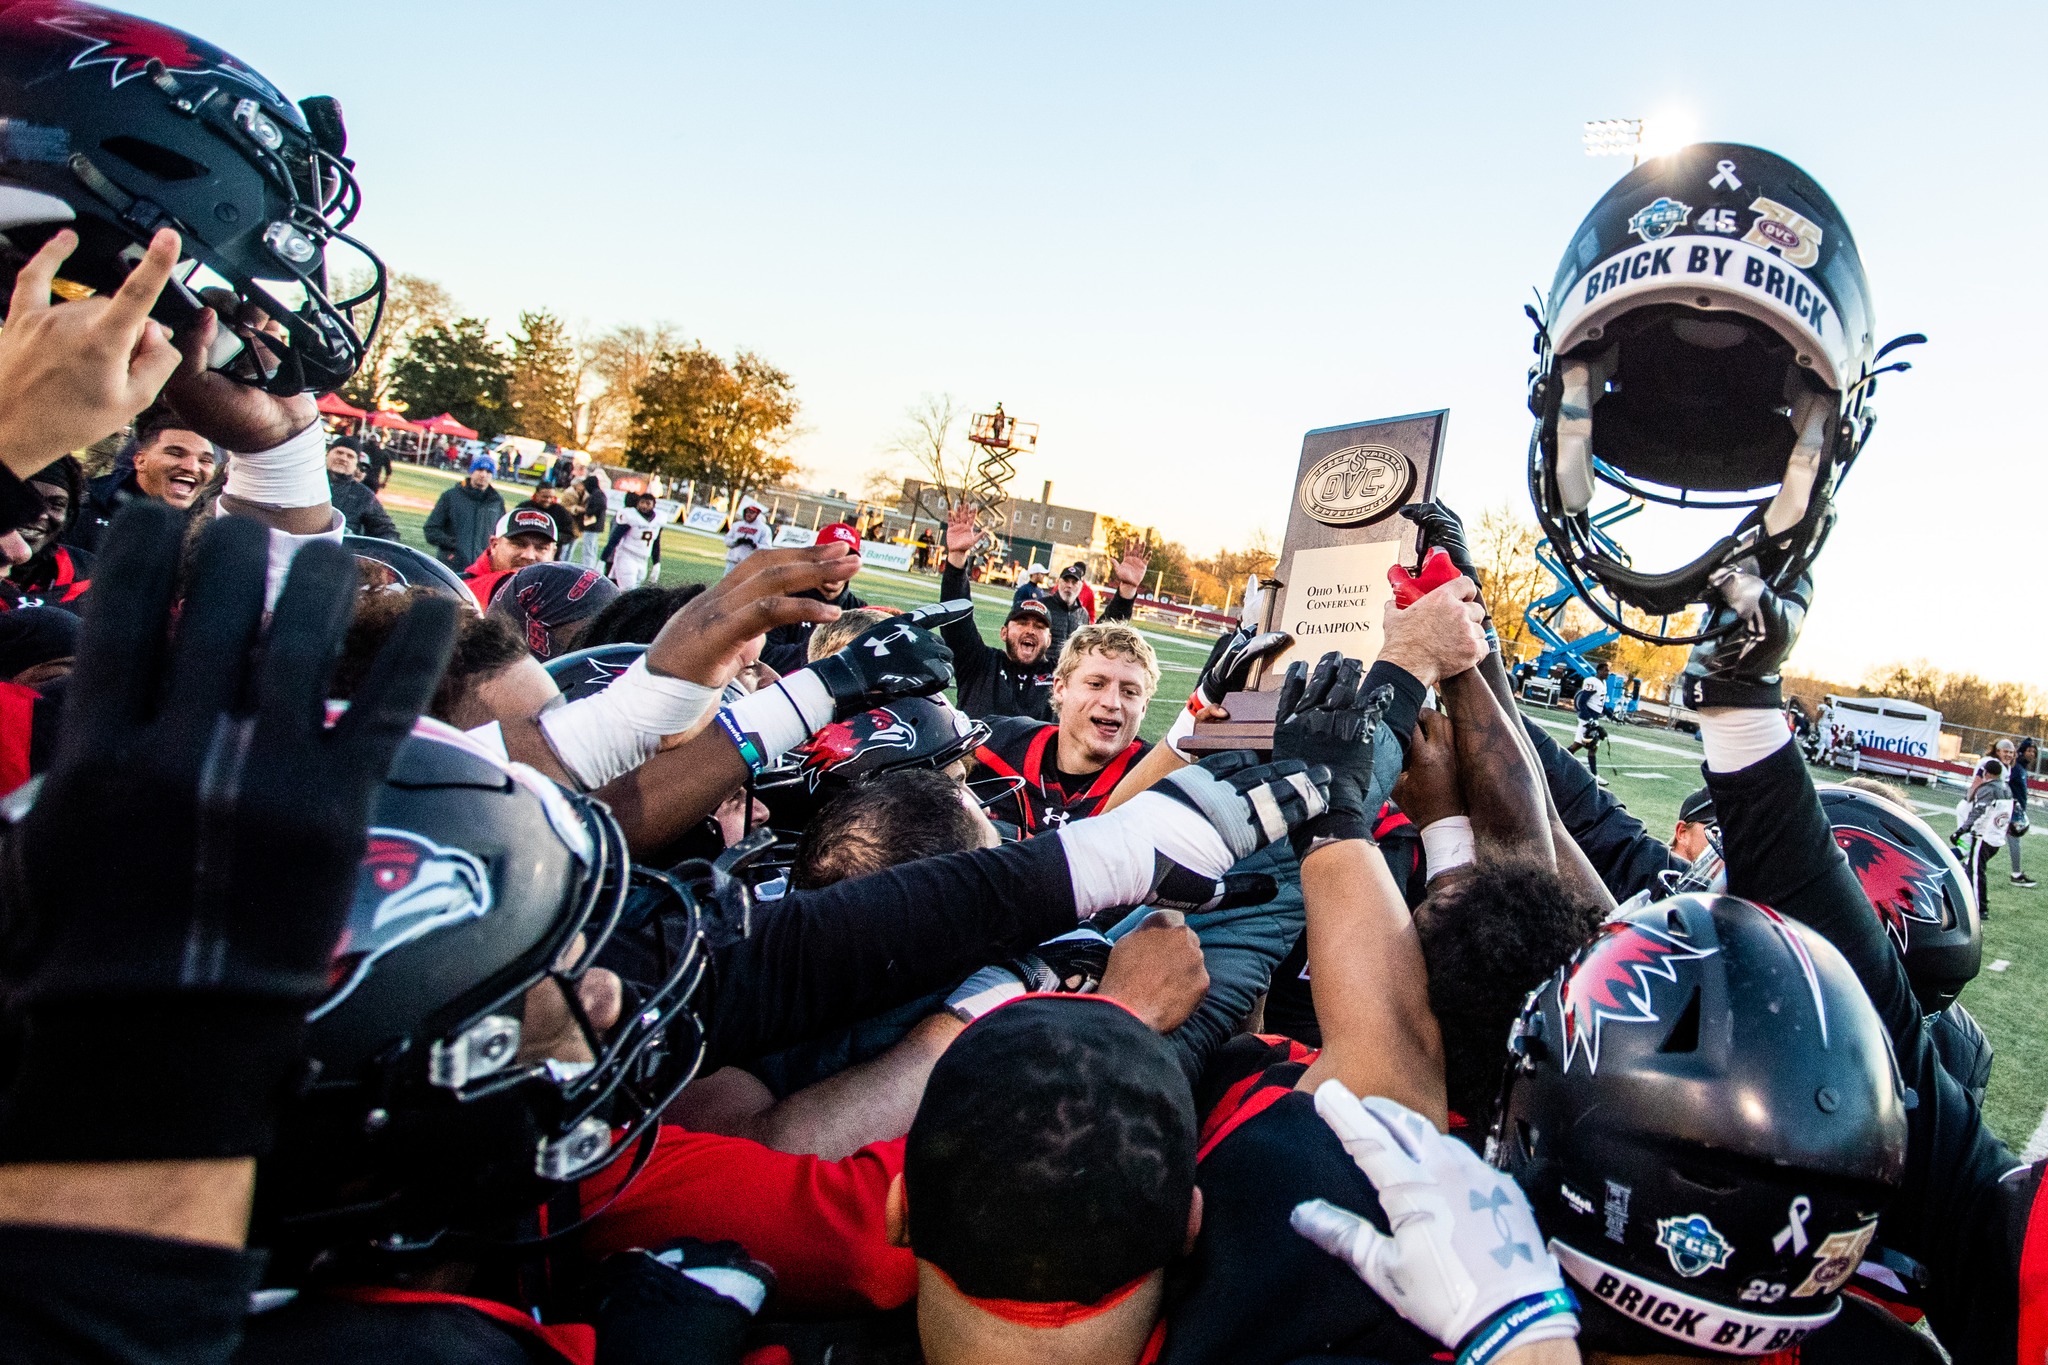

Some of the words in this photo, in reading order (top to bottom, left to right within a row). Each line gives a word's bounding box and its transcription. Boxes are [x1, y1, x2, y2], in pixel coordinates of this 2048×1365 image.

[1697, 208, 1737, 232] 45
[1765, 225, 1793, 243] OVC
[1584, 247, 1676, 305] BRICK
[1687, 245, 1733, 277] BY
[1743, 255, 1828, 337] BRICK
[1321, 466, 1385, 502] OVC
[866, 550, 907, 565] Banterra
[1307, 586, 1333, 597] OHIO
[1336, 584, 1371, 595] VALLEY
[1306, 598, 1367, 611] CONFERENCE
[1296, 621, 1370, 636] CHAMPIONS
[1668, 1230, 1718, 1259] FCS
[1594, 1272, 1708, 1337] BRICK
[1711, 1320, 1765, 1349] BY
